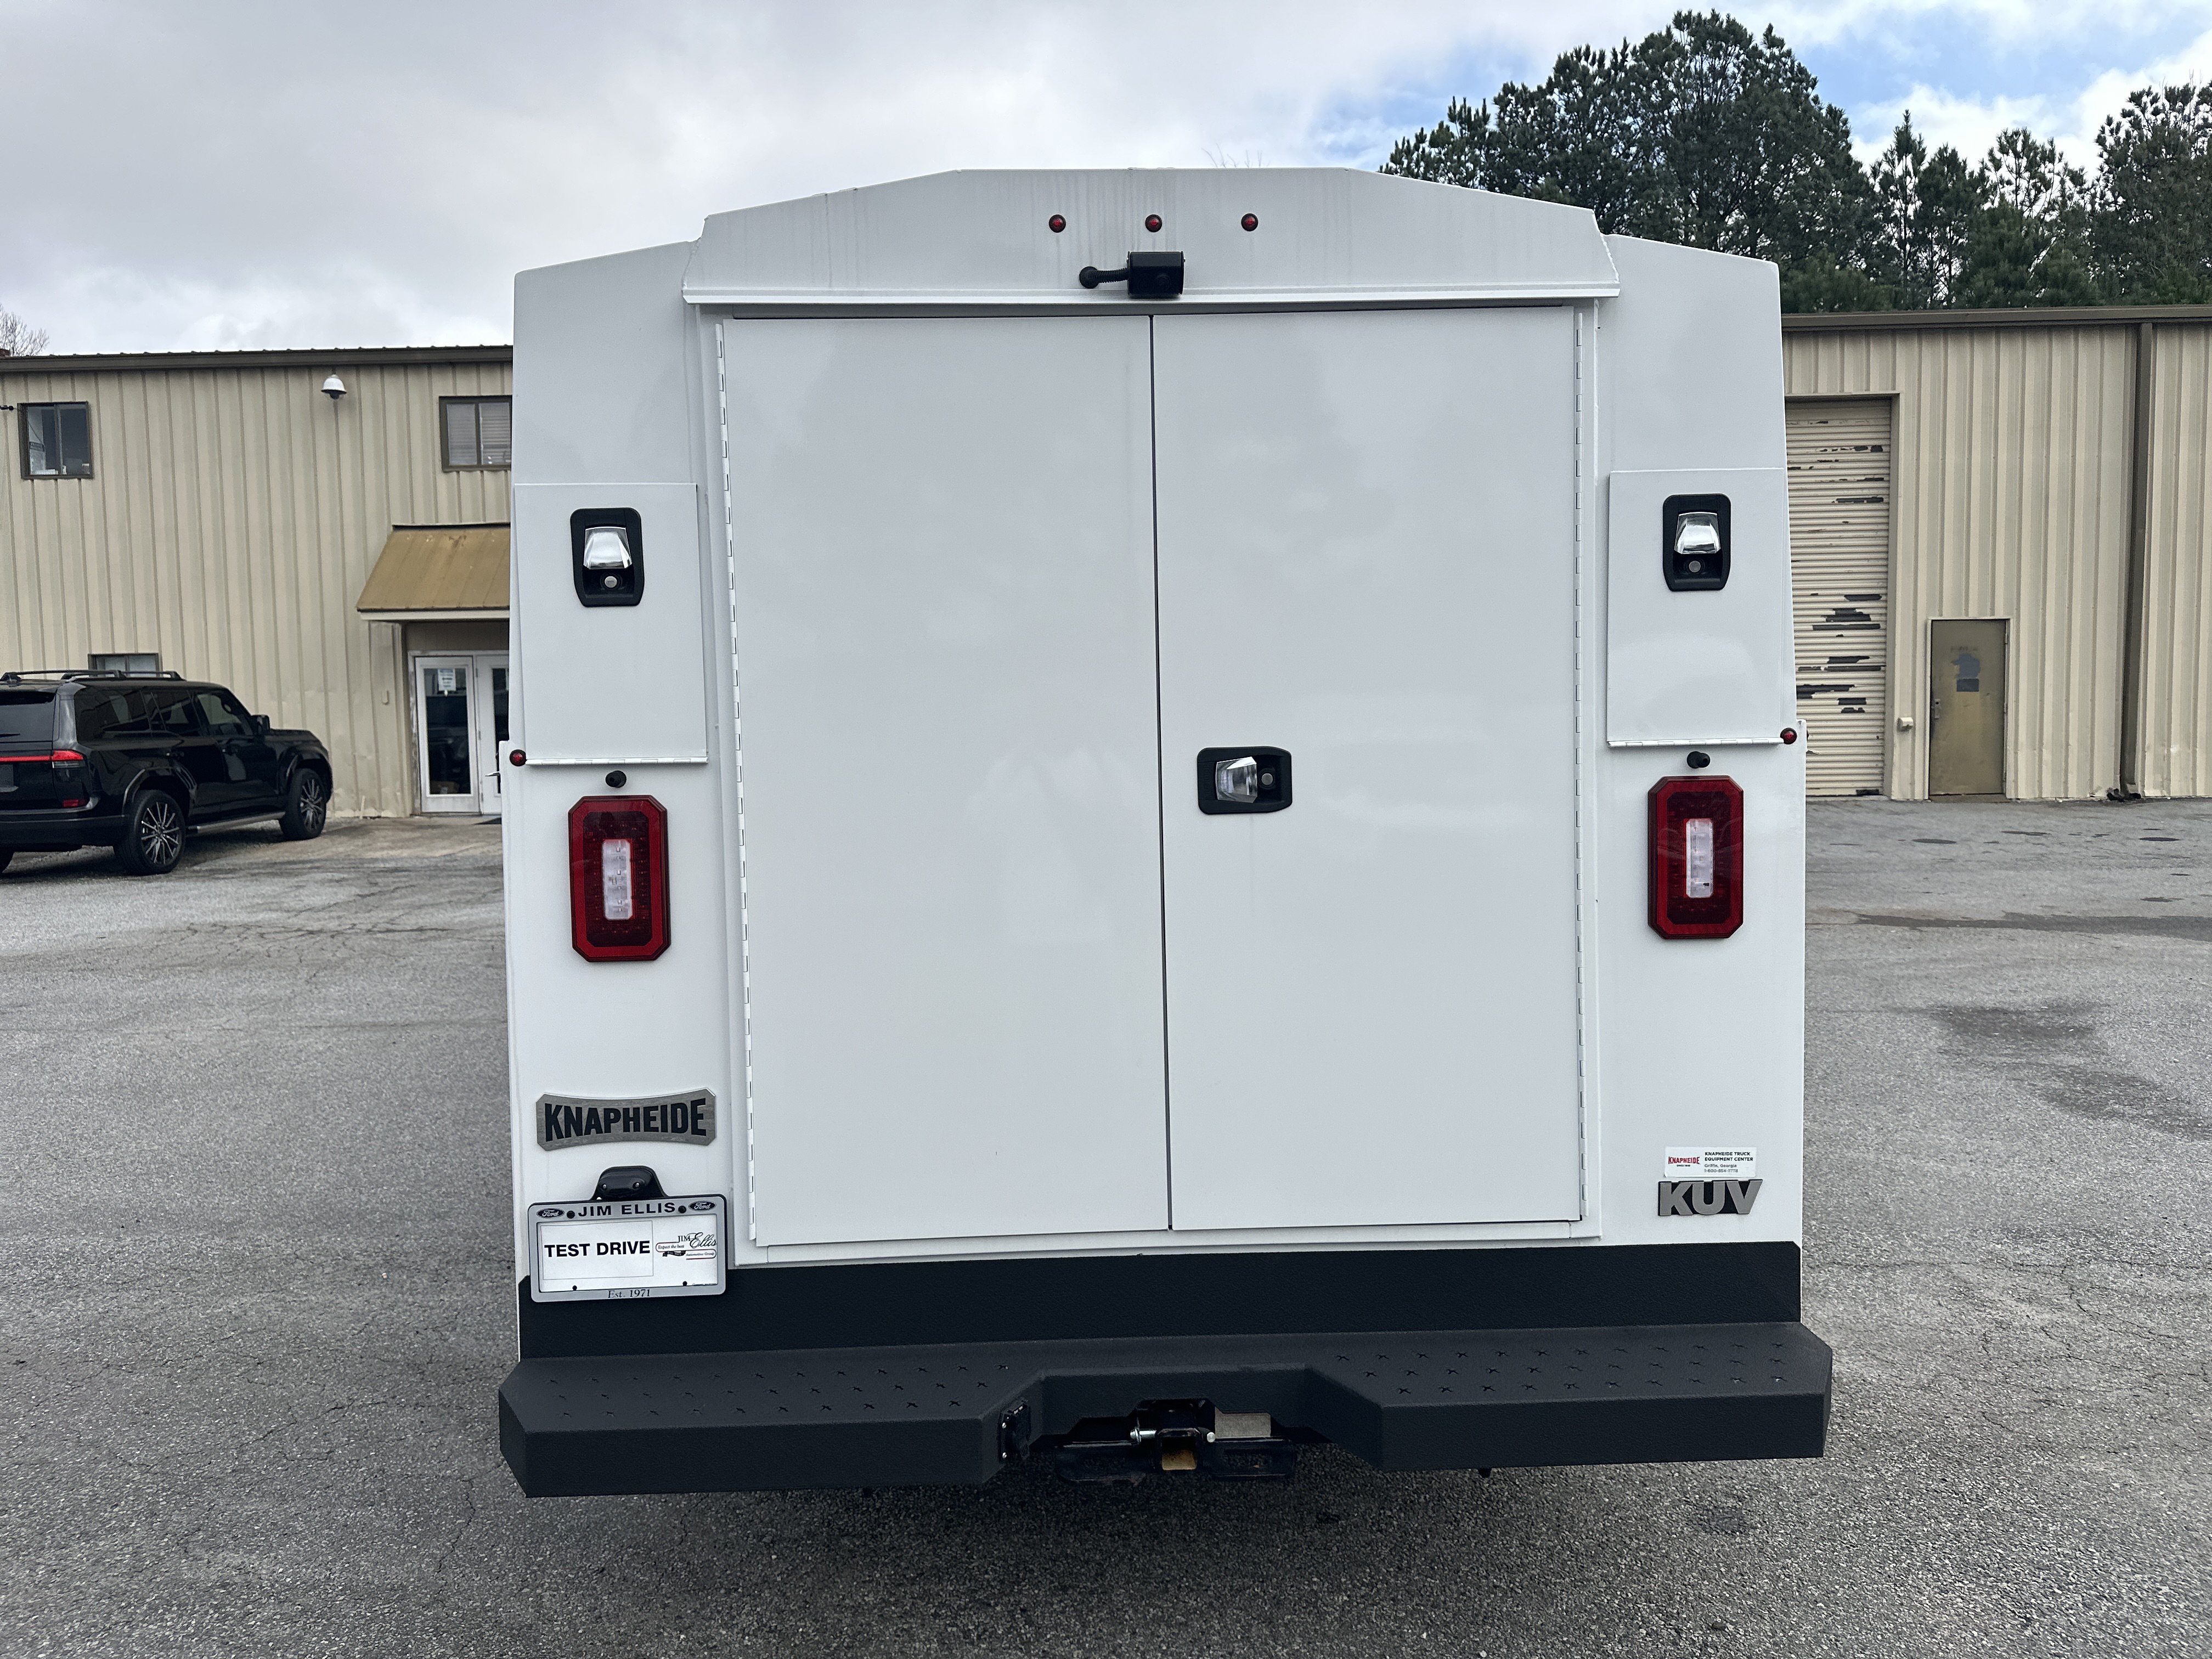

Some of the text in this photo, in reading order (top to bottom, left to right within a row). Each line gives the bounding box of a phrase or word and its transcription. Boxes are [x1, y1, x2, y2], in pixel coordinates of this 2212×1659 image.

[545, 1098, 706, 1142] KNAPHEIDE
[1668, 1156, 1700, 1164] KNAPHEIDE
[1658, 1179, 1763, 1216] KUV
[578, 1202, 675, 1217] JIM ELLIS
[544, 1240, 650, 1257] TEST DRIVE
[687, 1232, 717, 1249] Ellis
[607, 1289, 650, 1299] Est. 1971
